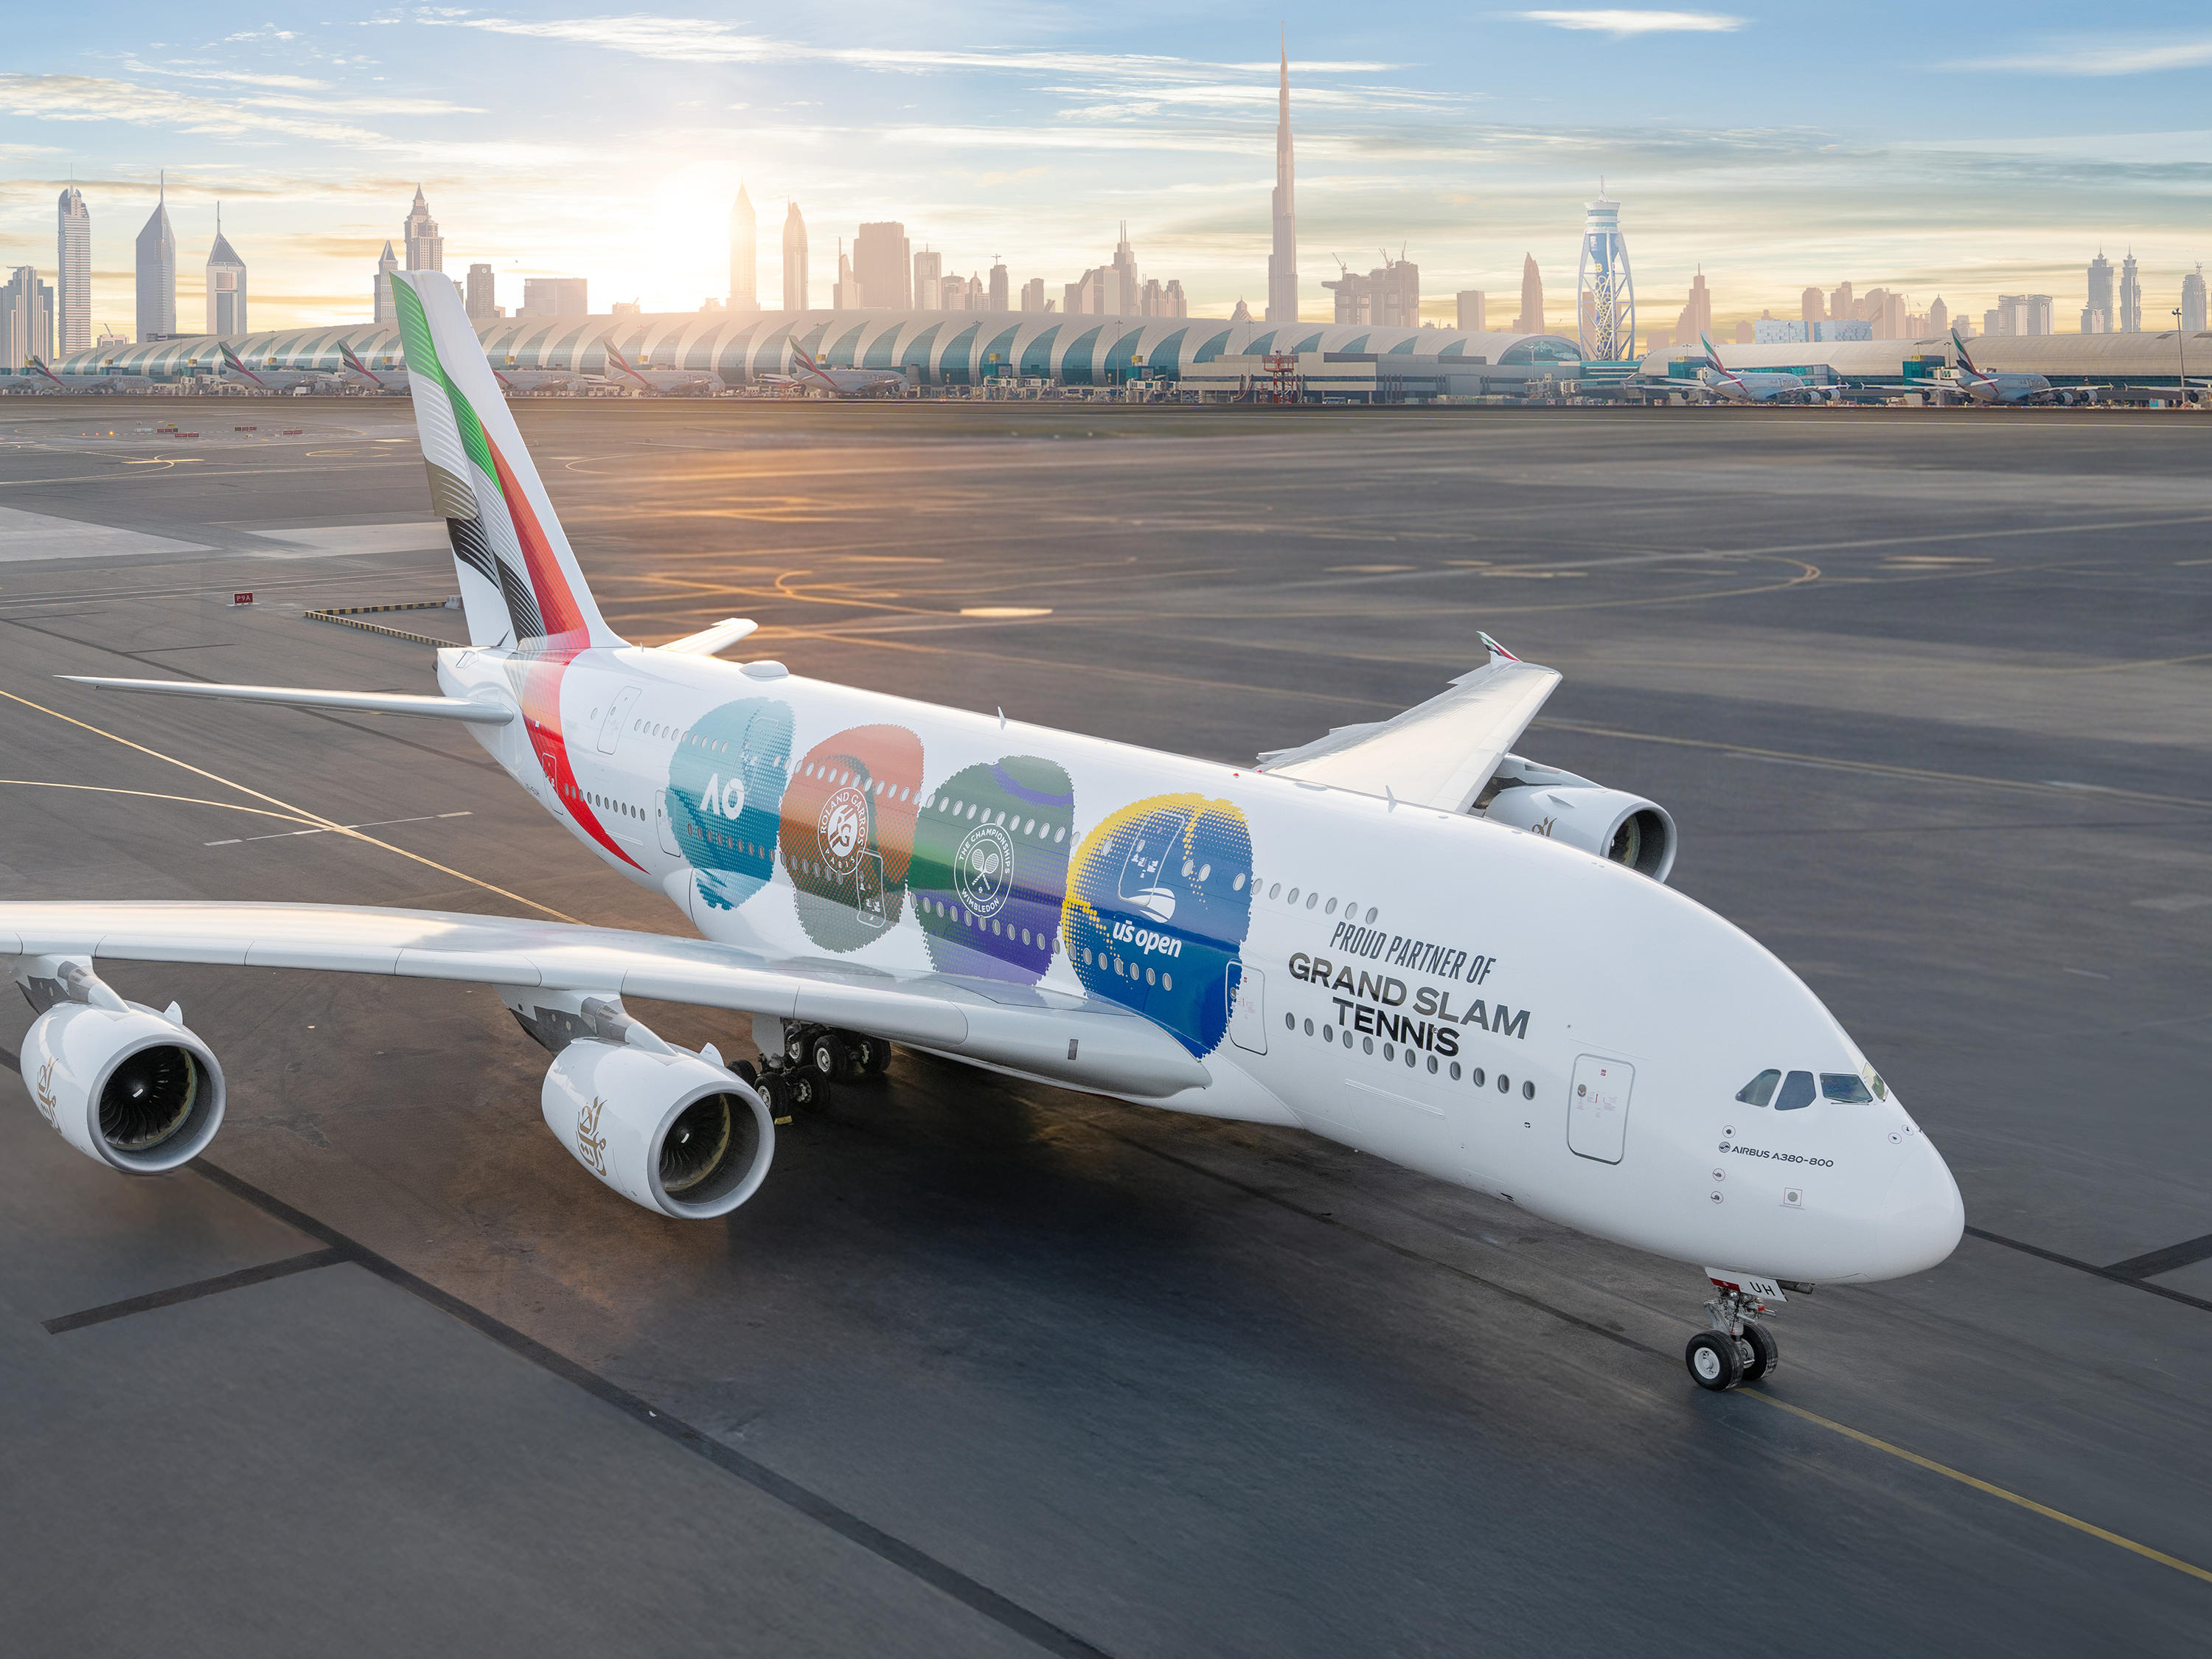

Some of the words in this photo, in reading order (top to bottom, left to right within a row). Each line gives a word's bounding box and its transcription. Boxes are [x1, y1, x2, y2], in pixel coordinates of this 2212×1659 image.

[820, 792, 849, 834] ROLAND
[851, 794, 866, 846] GARROS
[825, 848, 855, 869] PARIS
[959, 841, 971, 861] THE
[970, 828, 1011, 874] CHAMPIONSHIPS
[961, 888, 1000, 913] WIMBLEDON
[1135, 929, 1182, 958] open
[1329, 921, 1387, 959] PROUD
[1386, 936, 1467, 980] PARTNER
[1466, 955, 1496, 985] OF
[1288, 952, 1407, 1006] GRAND
[1412, 987, 1531, 1040] SLAM
[1332, 996, 1461, 1057] TENNIS
[1731, 1146, 1770, 1158] AIRBUS
[1771, 1152, 1834, 1167] A380-800
[1749, 1281, 1775, 1296] UH
